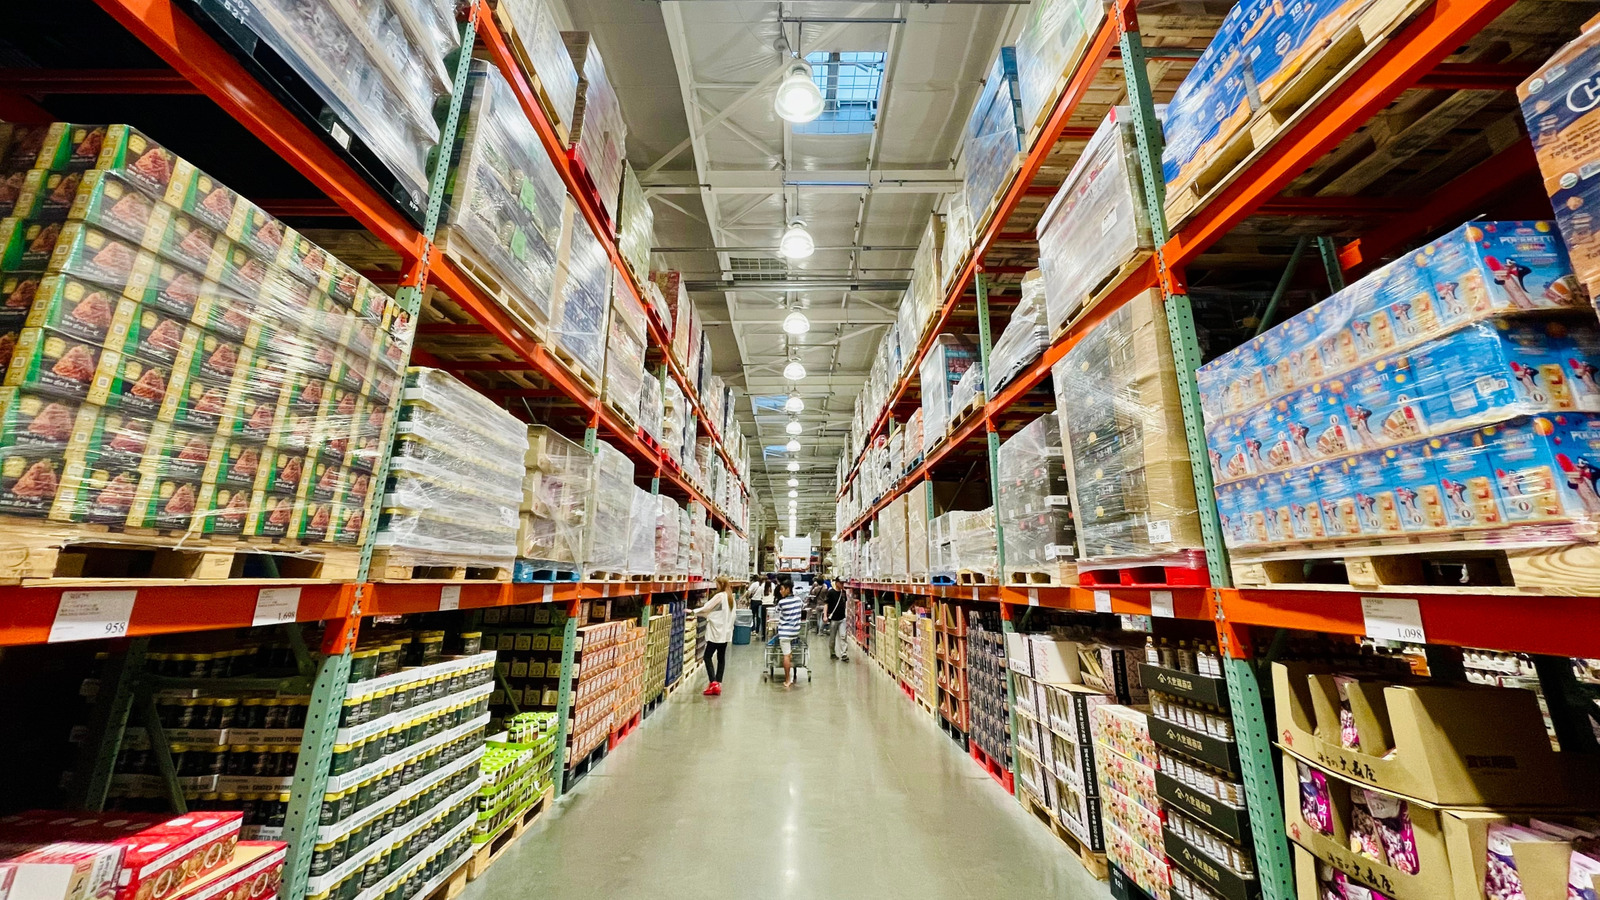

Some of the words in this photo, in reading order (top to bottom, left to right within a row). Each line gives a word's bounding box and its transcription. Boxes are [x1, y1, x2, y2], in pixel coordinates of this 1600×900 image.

[278, 612, 296, 620] 1,698
[104, 622, 126, 634] 958
[1397, 628, 1422, 639] 1,098
